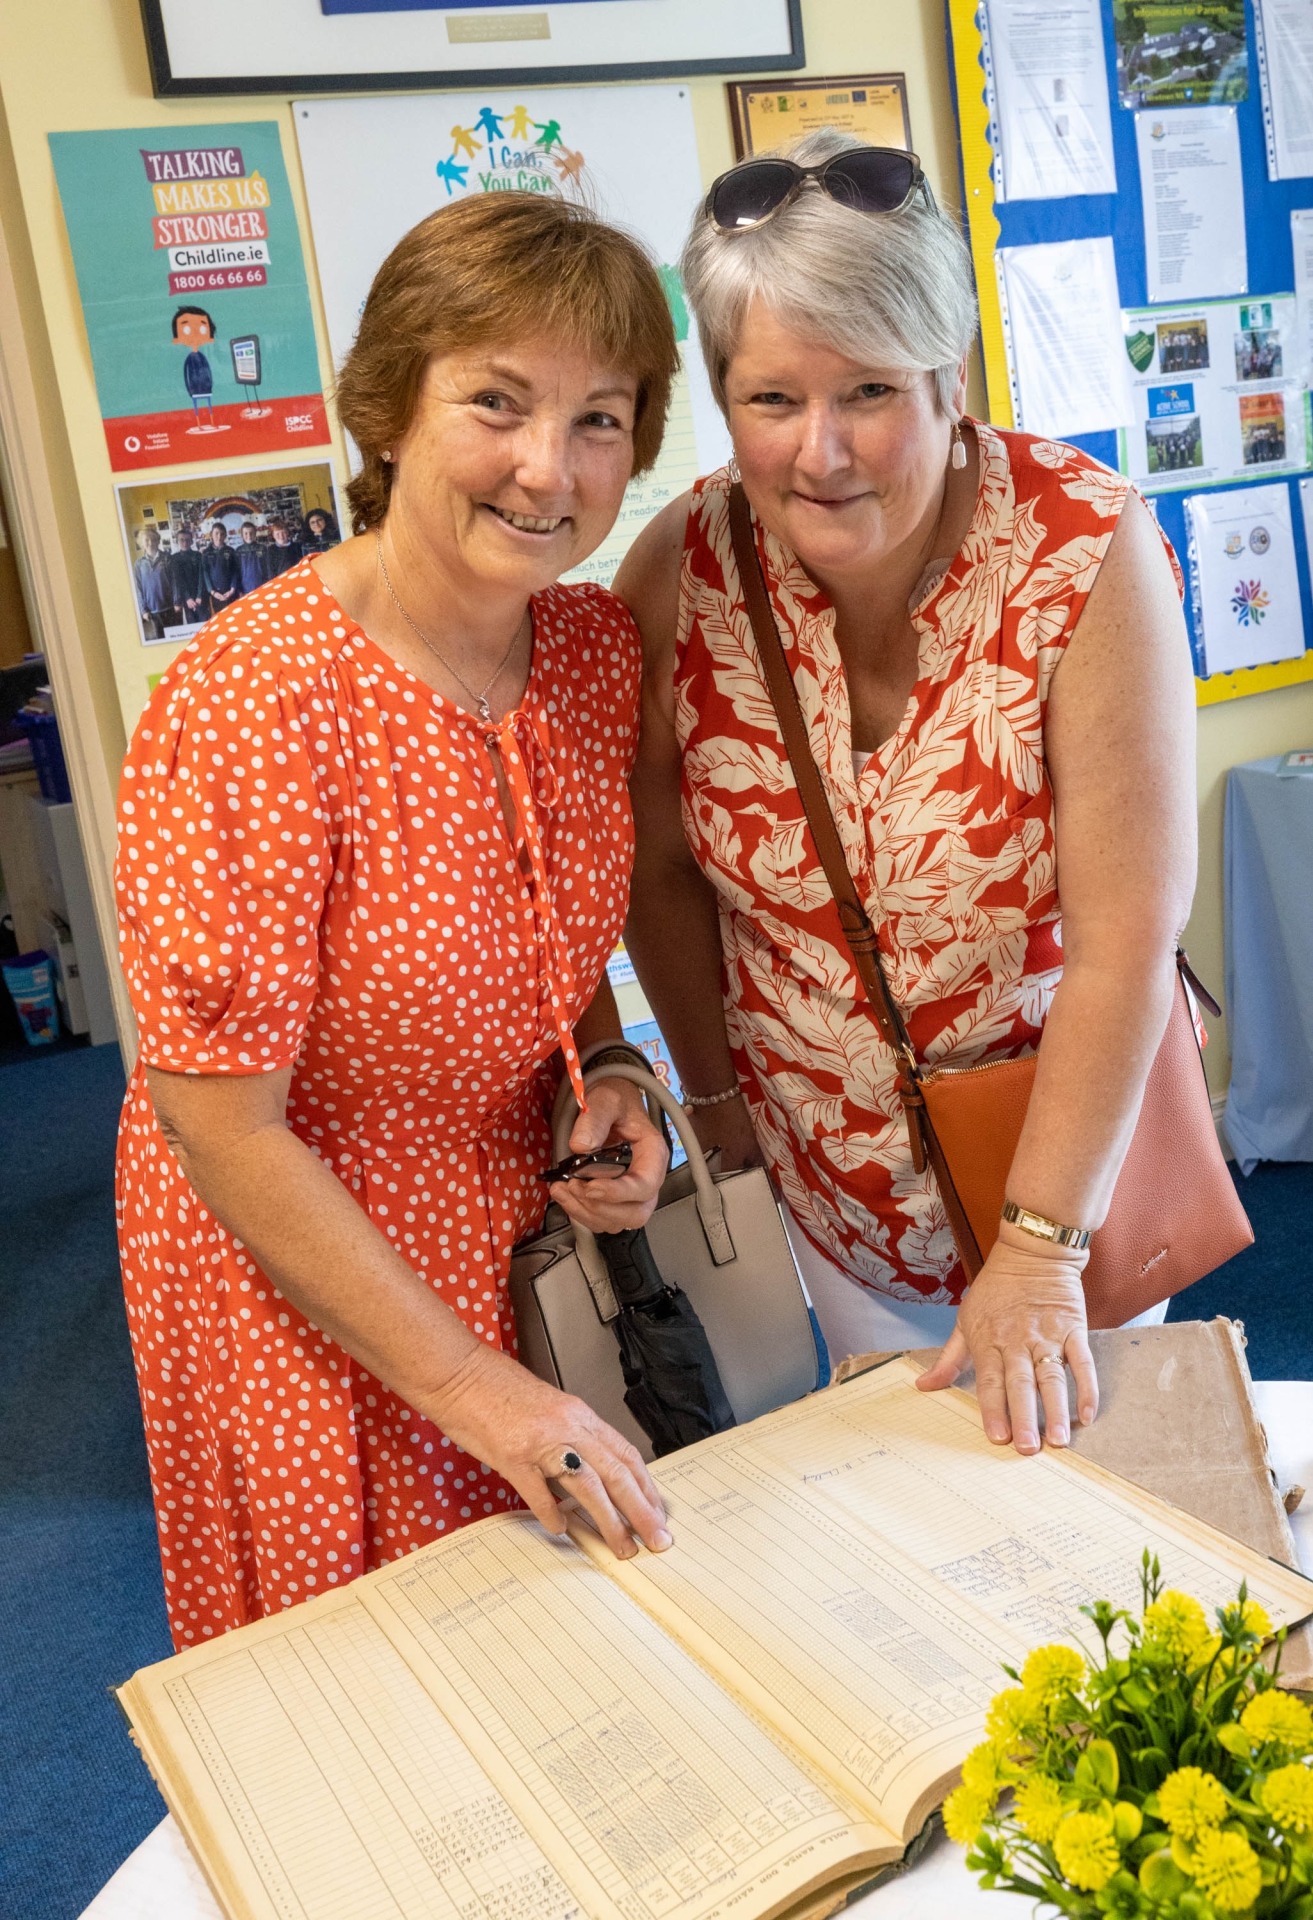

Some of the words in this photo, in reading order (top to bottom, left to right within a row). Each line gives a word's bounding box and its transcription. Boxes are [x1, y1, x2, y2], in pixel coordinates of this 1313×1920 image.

[148, 149, 240, 181] TALKING
[489, 146, 496, 169] I
[478, 171, 512, 192] You
[517, 170, 553, 192] Can
[156, 183, 232, 212] MAKES
[235, 180, 267, 206] US
[158, 212, 265, 245] STRONGER
[174, 246, 263, 266] Childline.ie
[174, 275, 205, 289] 1800
[208, 274, 224, 286] 66
[228, 272, 244, 284] 66
[246, 270, 262, 282] 66
[286, 415, 312, 426] ISPCC
[652, 488, 670, 498] She
